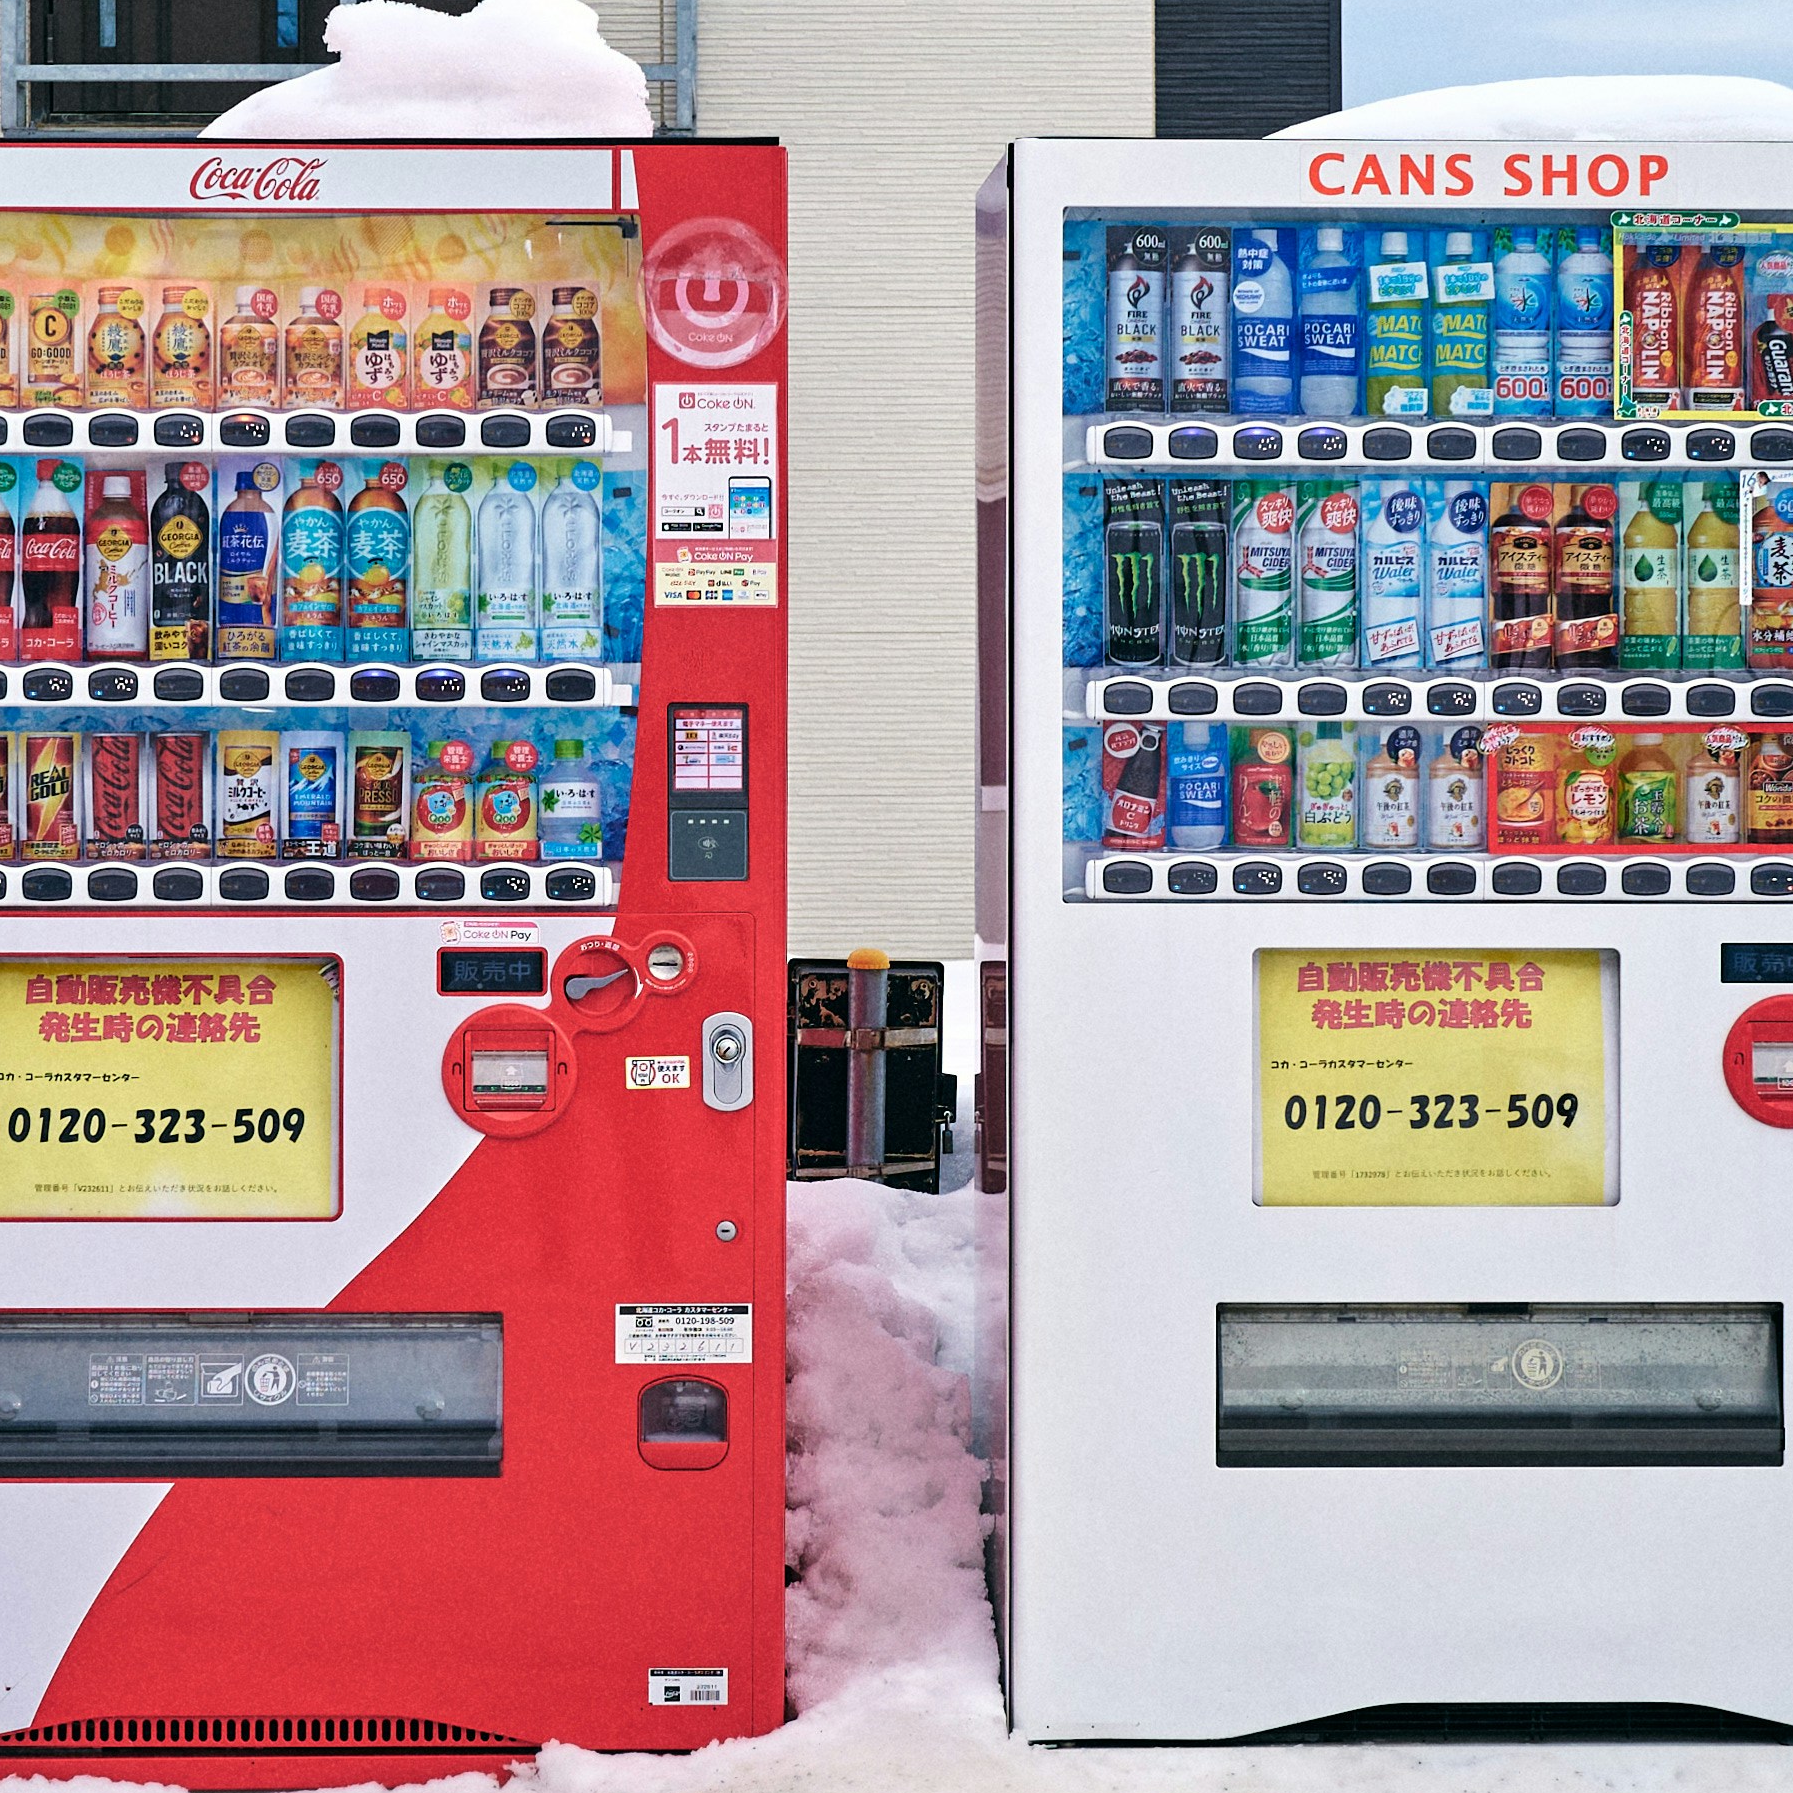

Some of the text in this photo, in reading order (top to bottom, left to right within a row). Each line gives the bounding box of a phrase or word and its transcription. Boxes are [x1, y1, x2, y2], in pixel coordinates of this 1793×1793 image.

[190, 157, 329, 200] Coca-Cola
[1308, 153, 1669, 197] CANS SHOP
[1632, 213, 1718, 226] 北海道コーナー
[1237, 248, 1269, 259] 熱中症
[1127, 310, 1148, 319] FIRE
[1191, 311, 1212, 320] FIRE
[45, 315, 56, 337] C
[1660, 291, 1672, 351] Ribbon
[1725, 291, 1737, 352] Ribbon
[1117, 323, 1156, 335] BLACK
[1181, 324, 1220, 336] BLACK
[1238, 324, 1290, 336] POCARI
[1304, 322, 1355, 334] POCARI
[1304, 333, 1352, 345] SWEAT
[1641, 291, 1660, 380] NAPOLIN
[1706, 291, 1725, 380] NAPOLIN
[1238, 336, 1286, 348] SWEAT
[31, 347, 71, 359] GO:GOOD
[1620, 325, 1631, 395] 北海道コーナー
[365, 353, 383, 383] ゆず
[429, 353, 448, 384] ゆず
[1496, 377, 1543, 399] 600
[1560, 377, 1607, 399] 600
[697, 398, 730, 409] Coke
[704, 423, 769, 432] スタンプたまると
[317, 473, 340, 485] 650
[381, 473, 405, 485] 650
[1106, 482, 1143, 496] Unleash
[1111, 484, 1161, 501] the Beast!
[1172, 483, 1210, 496] Unleash
[1177, 484, 1227, 502] the Beast!
[1260, 498, 1288, 510] スッキリ
[1325, 498, 1353, 510] スッキリ
[1391, 498, 1417, 512] 後味
[1455, 498, 1481, 512] 後味
[1261, 510, 1291, 527] 爽快
[1326, 510, 1356, 527] 爽快
[1389, 511, 1420, 527] すっきり
[1453, 511, 1484, 527] すっきり
[98, 538, 130, 547] GEORGIA
[161, 532, 200, 542] GEORGIA
[222, 536, 264, 549] 紅茶花伝
[25, 537, 77, 560] Coca-Cola
[286, 529, 338, 558] 麦茶
[350, 530, 406, 560] 麦茶
[694, 552, 718, 561] Coke
[735, 552, 753, 563] Pay
[1249, 547, 1291, 557] MITSUYA
[1314, 547, 1356, 557] MITSUYA
[1500, 551, 1547, 563] アイスティー
[1565, 551, 1611, 563] アイスティー
[1262, 558, 1291, 567] CIDER
[1326, 558, 1355, 567] CIDER
[1373, 555, 1415, 565] カルピス
[1437, 555, 1479, 565] カルピス
[1770, 536, 1793, 585] 麦茶
[154, 561, 208, 585] BLACK
[1372, 565, 1415, 581] Water
[1436, 565, 1479, 581] Water
[107, 565, 119, 628] ミルクコーヒー
[227, 630, 265, 642] ひろがる
[1250, 634, 1278, 642] 日本品質
[1315, 634, 1343, 642] 日本品質
[25, 638, 75, 647] コカ・コーラ
[222, 642, 270, 653] 紅茶の余韻
[414, 640, 469, 649] シャインマスカット
[447, 745, 464, 755] 管理
[1506, 745, 1535, 756] じっくり
[443, 754, 468, 763] 栄養士
[1504, 755, 1535, 766] コトコト
[30, 765, 67, 788] REAL
[30, 779, 70, 802] GOLD
[1179, 782, 1220, 791] POCARI
[228, 787, 266, 799] ミルクコーヒー
[294, 793, 331, 801] EMERALD
[1179, 790, 1218, 800] SWEAT
[1570, 793, 1607, 806] レモン
[1698, 800, 1731, 810] 午後の紅茶
[1116, 799, 1150, 814] オロナミン
[1376, 801, 1410, 811] 午後の紅茶
[1440, 801, 1473, 811] 午後の紅茶
[1652, 788, 1664, 835] 玉露入り
[428, 813, 451, 824] Qoo
[493, 813, 517, 824] Qoo
[1126, 811, 1134, 820] C
[1304, 810, 1352, 824] 白ぶどう
[1633, 798, 1649, 835] お茶
[1119, 820, 1139, 829] ドリンク
[101, 849, 137, 857] ゼロカロリー
[164, 849, 201, 857] ゼロカロリー
[306, 839, 339, 857] 王道
[463, 929, 491, 941] Coke
[510, 930, 531, 943] Pay
[453, 959, 532, 983] 販売中
[1297, 960, 1546, 992] 自動販売機不具合
[26, 973, 277, 1006] 自動販売機不具合
[1311, 998, 1532, 1029] 発生時の連絡先
[38, 1011, 261, 1044] 発生時の連絡先
[657, 1064, 686, 1073] 使えます
[1270, 1059, 1413, 1070] コカ・コーラカスタマーセンター
[662, 1073, 680, 1084] OK
[1284, 1093, 1578, 1130] 0120-323-509
[7, 1107, 305, 1144] 0120-323-509
[675, 1316, 735, 1325] 0120-198-509
